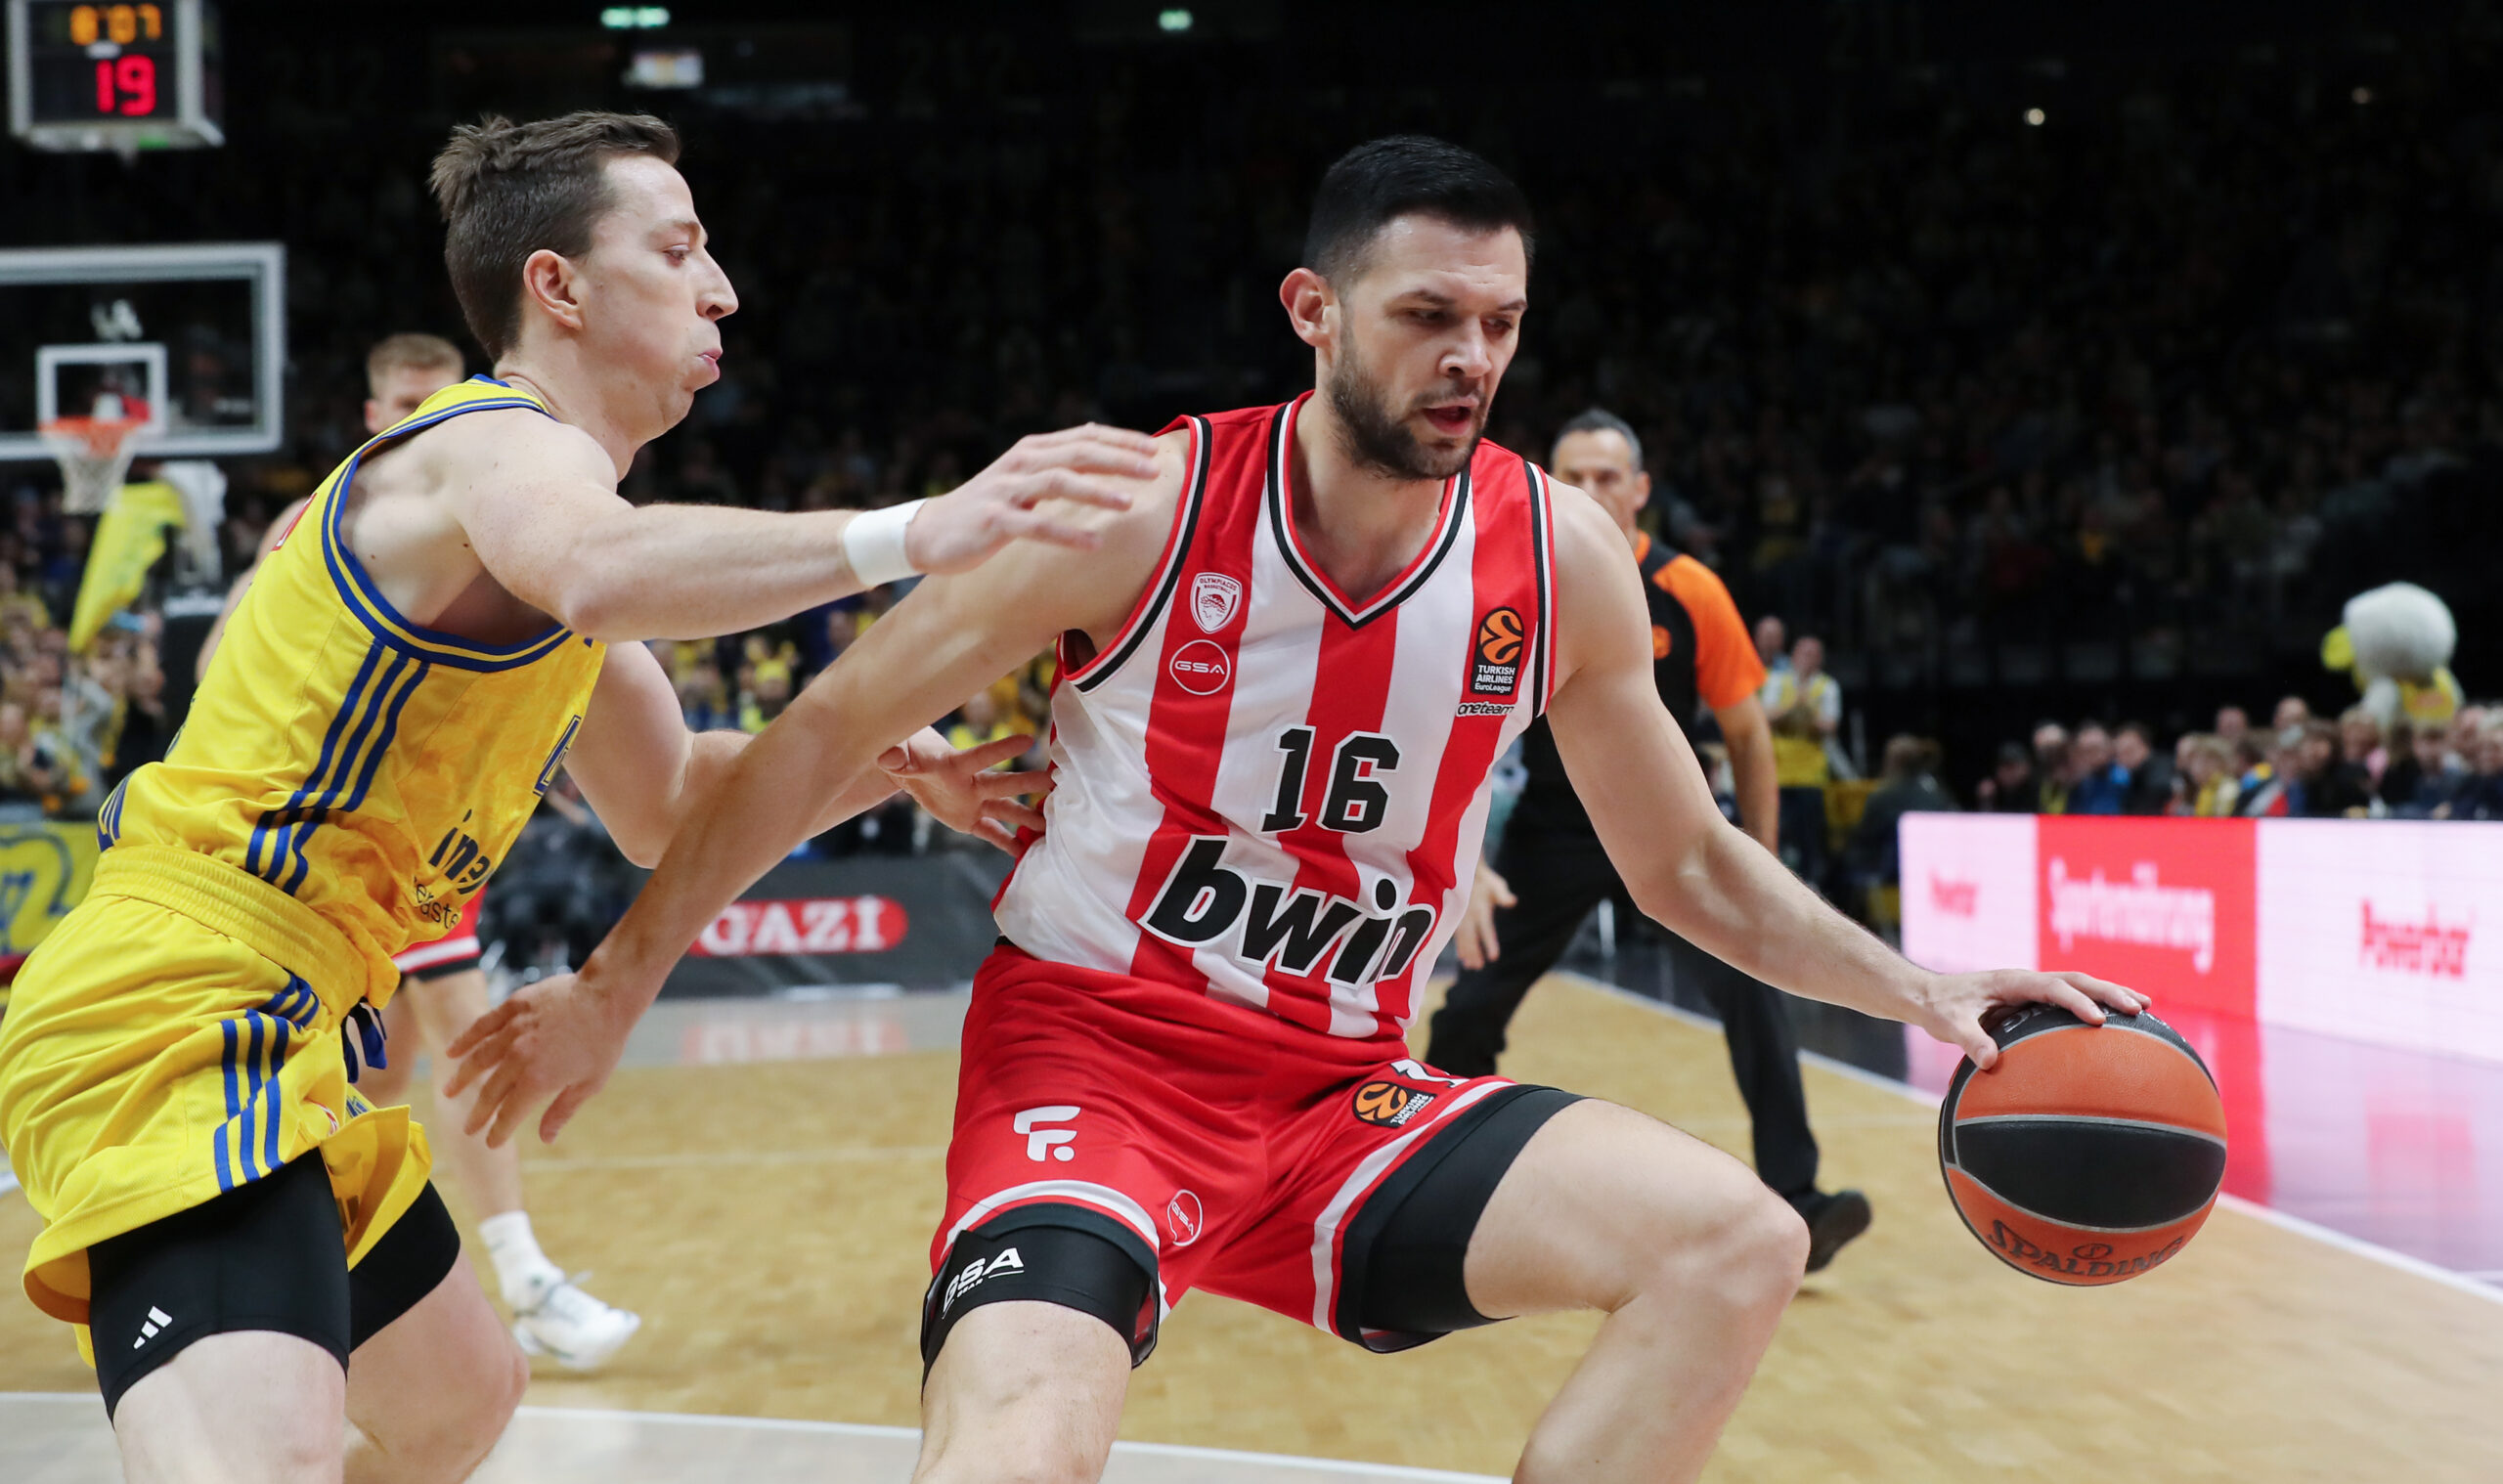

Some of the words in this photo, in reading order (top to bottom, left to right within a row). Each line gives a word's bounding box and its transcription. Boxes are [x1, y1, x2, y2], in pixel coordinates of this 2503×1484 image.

[95, 54, 156, 116] 19
[1174, 660, 1226, 676] GSA
[1474, 682, 1512, 694] EuroLeague
[1475, 674, 1514, 685] AIRLINES
[1477, 665, 1515, 677] TURKISH
[1260, 725, 1400, 834] 16
[698, 895, 886, 955] GAZI
[1141, 835, 1435, 988] bwin
[1988, 1219, 2184, 1277] SPALDING
[943, 1247, 1024, 1313] GSA
